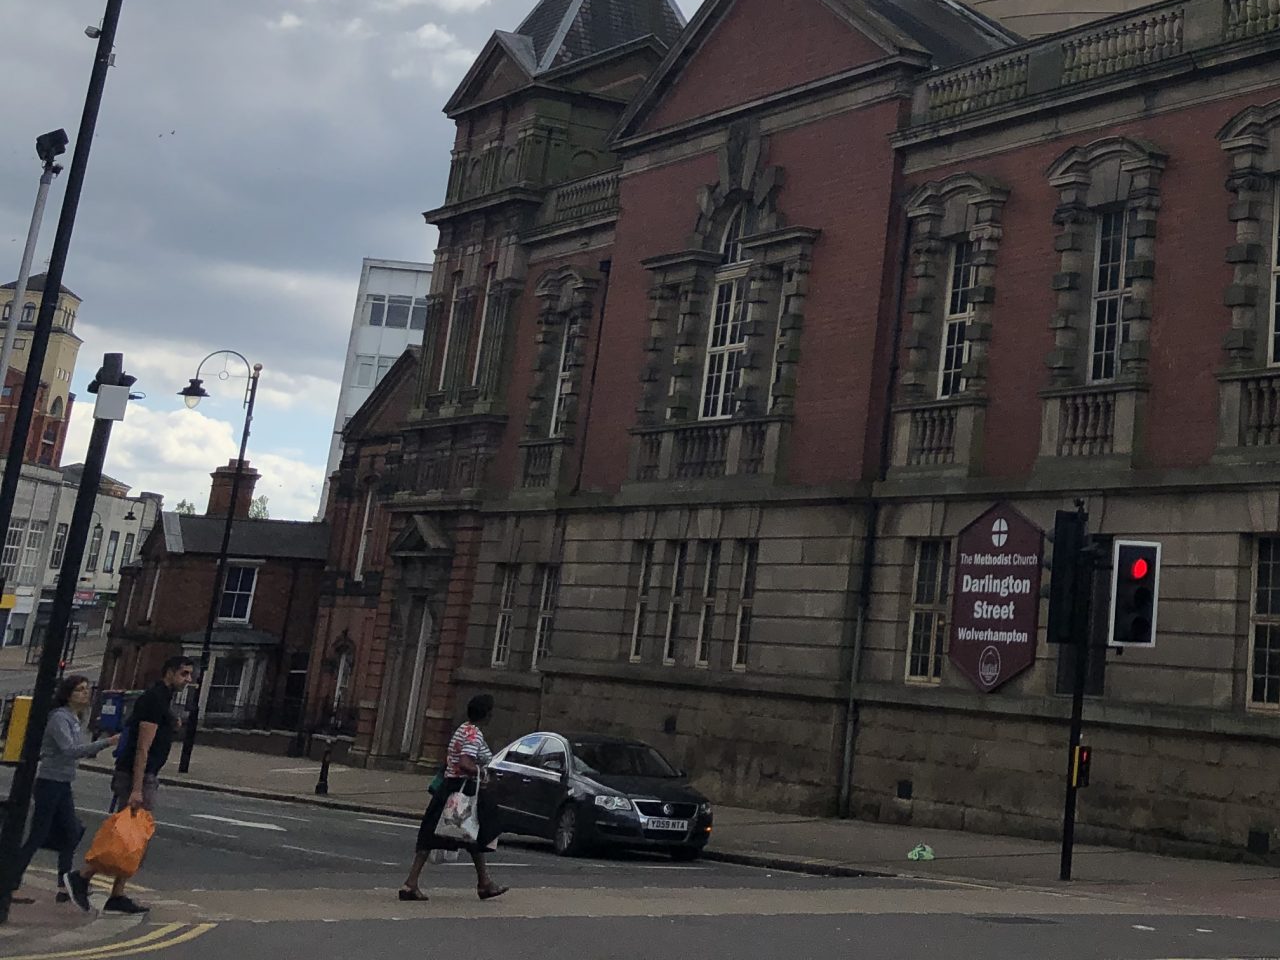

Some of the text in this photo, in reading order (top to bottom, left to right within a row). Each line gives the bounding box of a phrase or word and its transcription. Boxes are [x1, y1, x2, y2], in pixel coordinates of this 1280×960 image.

[961, 553, 1038, 566] The Methodist Church
[962, 574, 1031, 597] Darlington
[973, 600, 1015, 620] Street
[958, 626, 1028, 644] Wolverhampton
